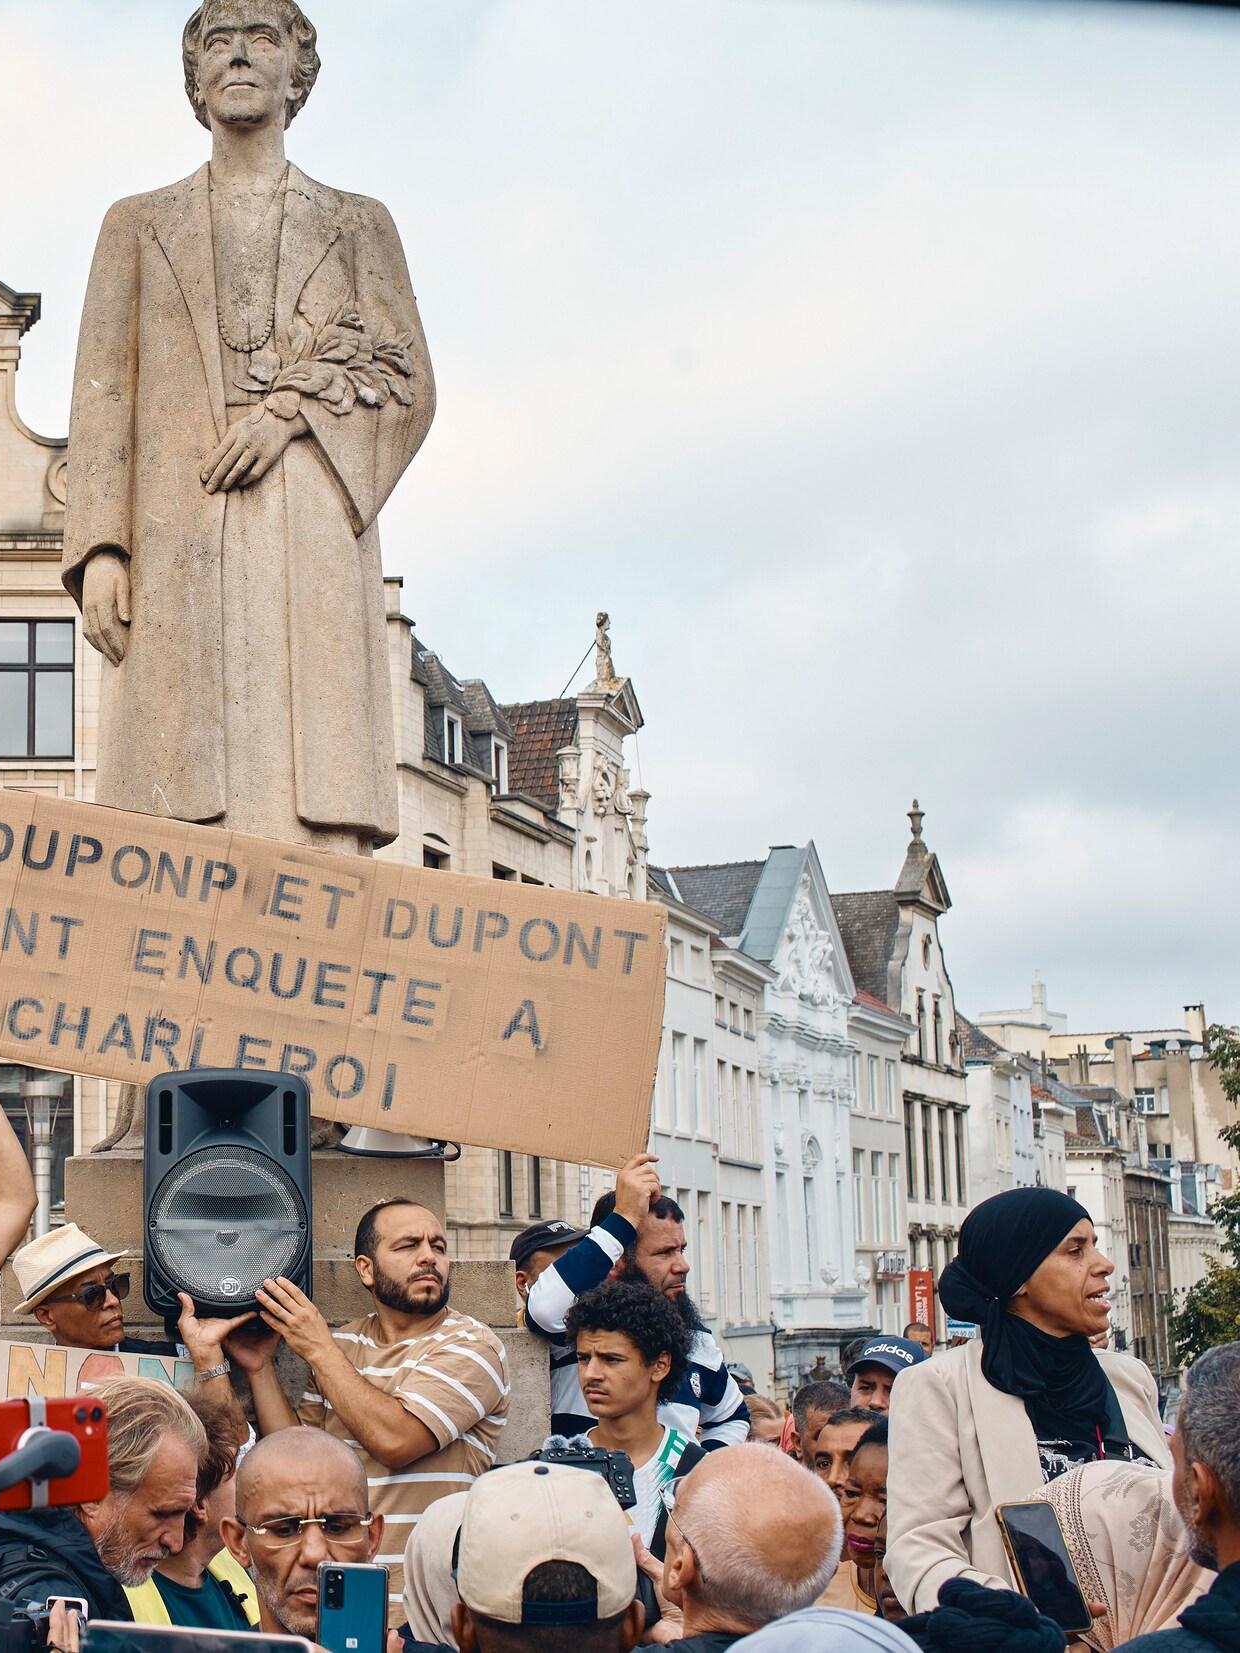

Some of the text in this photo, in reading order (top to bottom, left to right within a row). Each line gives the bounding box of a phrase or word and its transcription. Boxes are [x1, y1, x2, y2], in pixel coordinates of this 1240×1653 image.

[270, 873, 355, 929] ET
[382, 898, 649, 975] DUPONT
[134, 928, 442, 1026] ENQUETE
[501, 999, 542, 1052] A
[7, 997, 397, 1111] CHARLEROI
[864, 1343, 914, 1364] adidas
